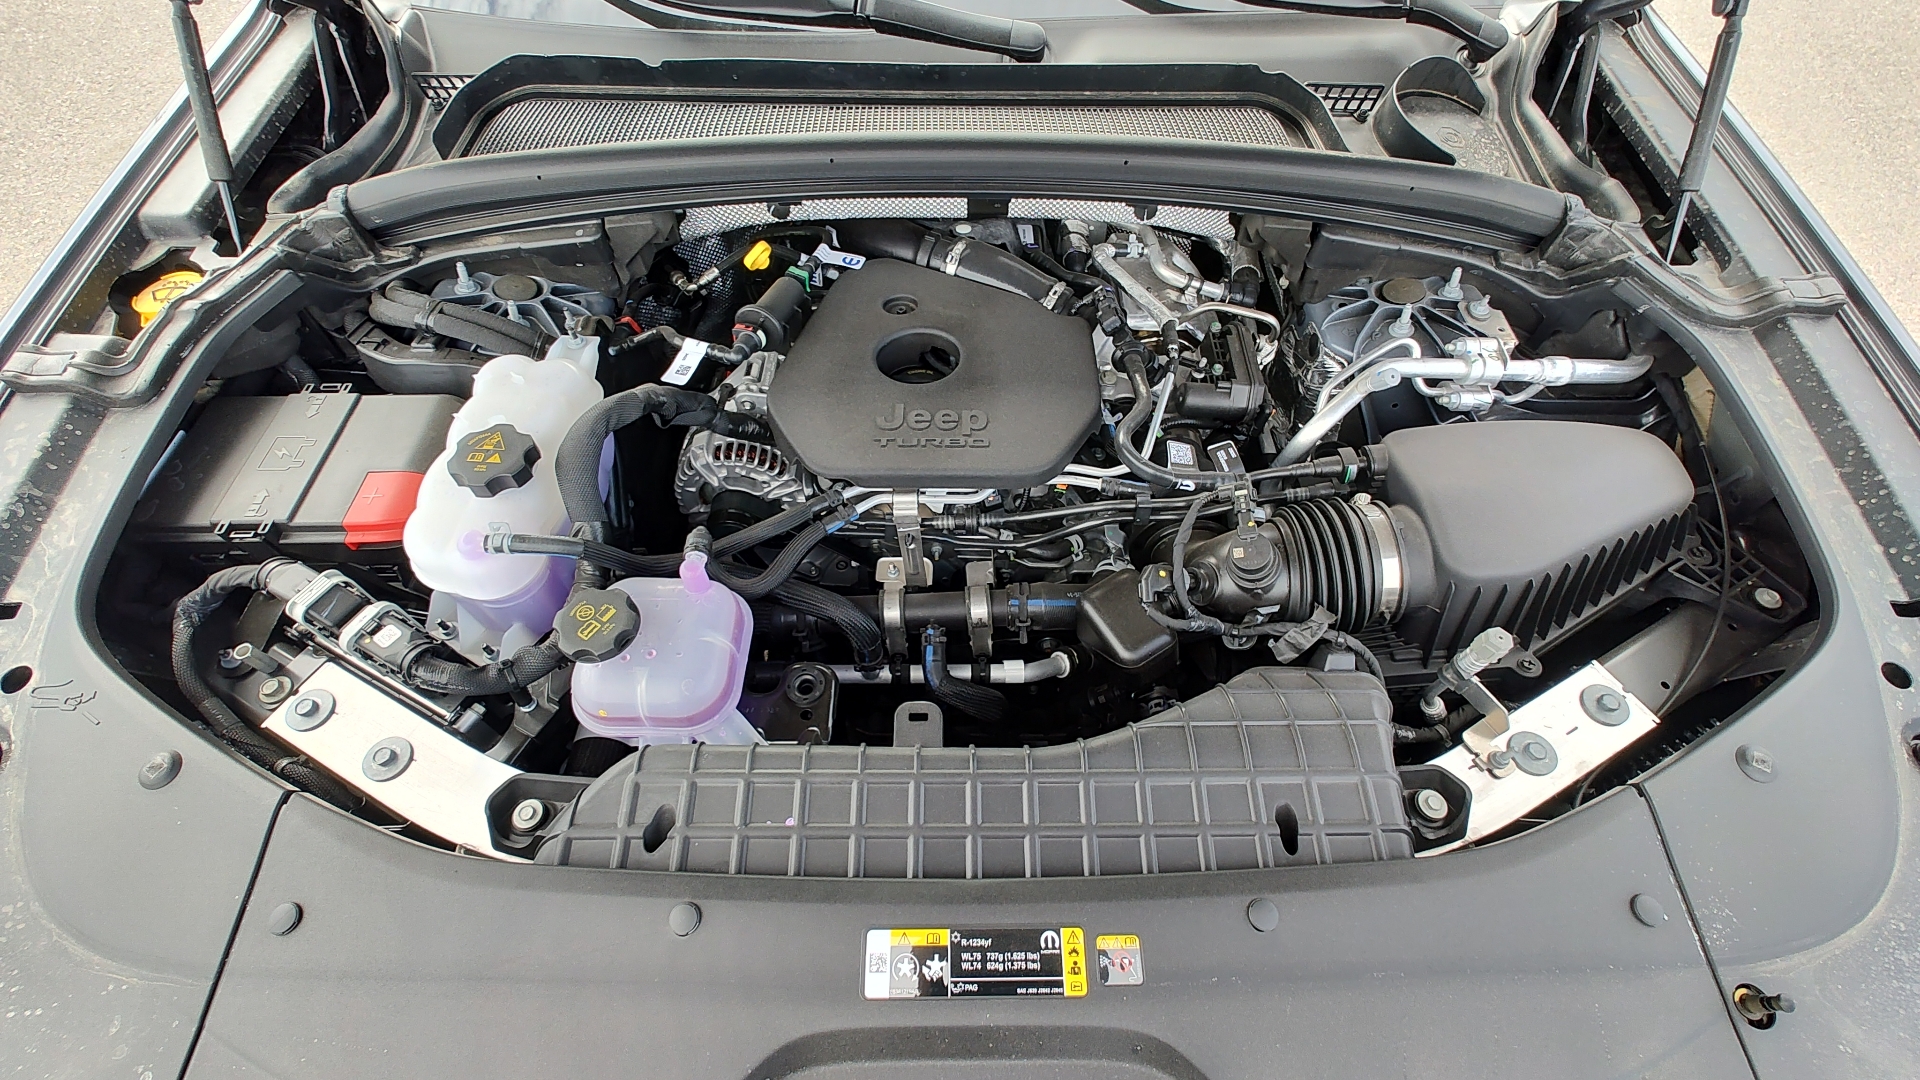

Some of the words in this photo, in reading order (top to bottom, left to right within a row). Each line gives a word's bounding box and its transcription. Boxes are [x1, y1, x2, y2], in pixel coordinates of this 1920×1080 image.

[875, 403, 989, 436] Jeep
[874, 437, 990, 448] TURBO
[961, 938, 992, 948] R-1234yf
[961, 952, 982, 961] WL75
[986, 952, 1004, 962] 737g
[1004, 952, 1026, 962] (1.625
[1026, 952, 1040, 962] lbs)
[961, 961, 982, 971] WL74
[986, 961, 1004, 972] 624g
[1004, 961, 1026, 972] (1.375
[1026, 961, 1041, 972] lbs)
[965, 984, 979, 992] PAG
